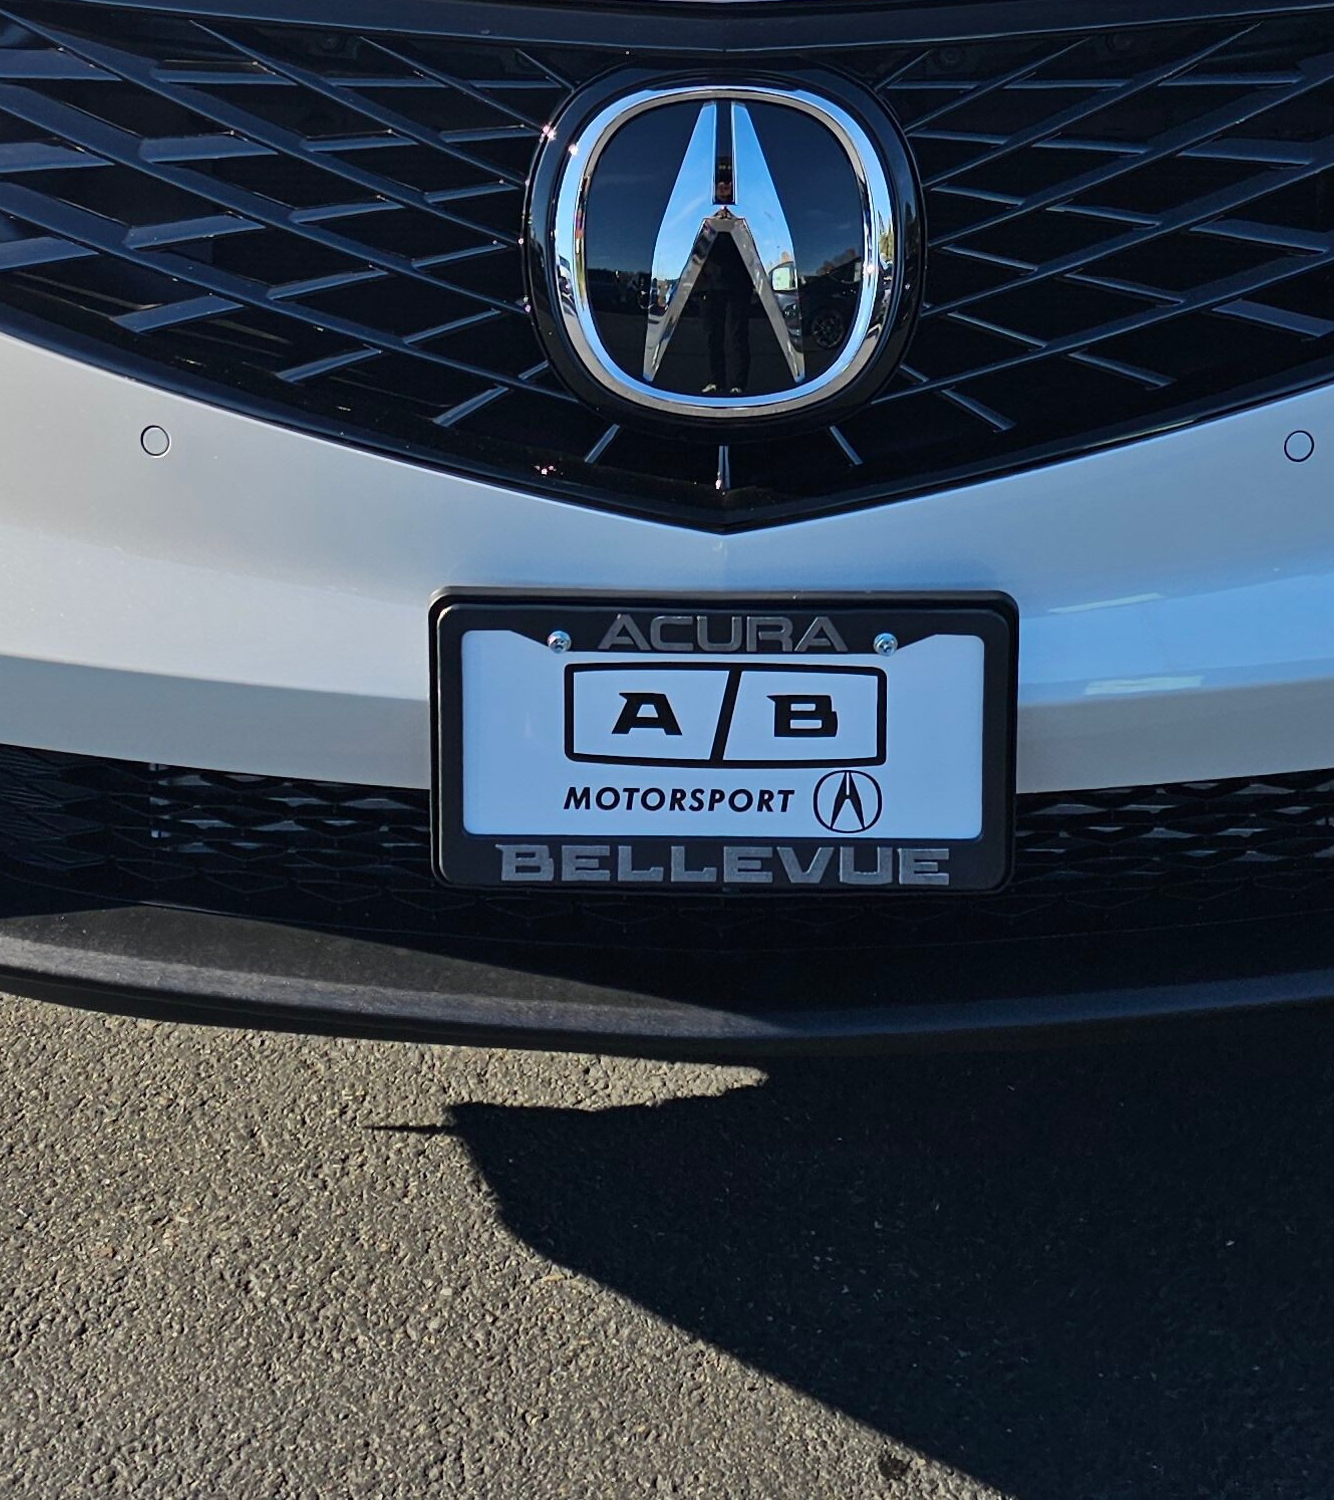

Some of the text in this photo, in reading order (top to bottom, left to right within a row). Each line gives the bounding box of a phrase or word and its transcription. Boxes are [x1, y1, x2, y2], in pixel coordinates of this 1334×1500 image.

[598, 614, 848, 653] ACURA
[611, 692, 838, 738] A B
[563, 785, 795, 813] MOTORSPORT
[495, 843, 951, 886] BELLEVUE
